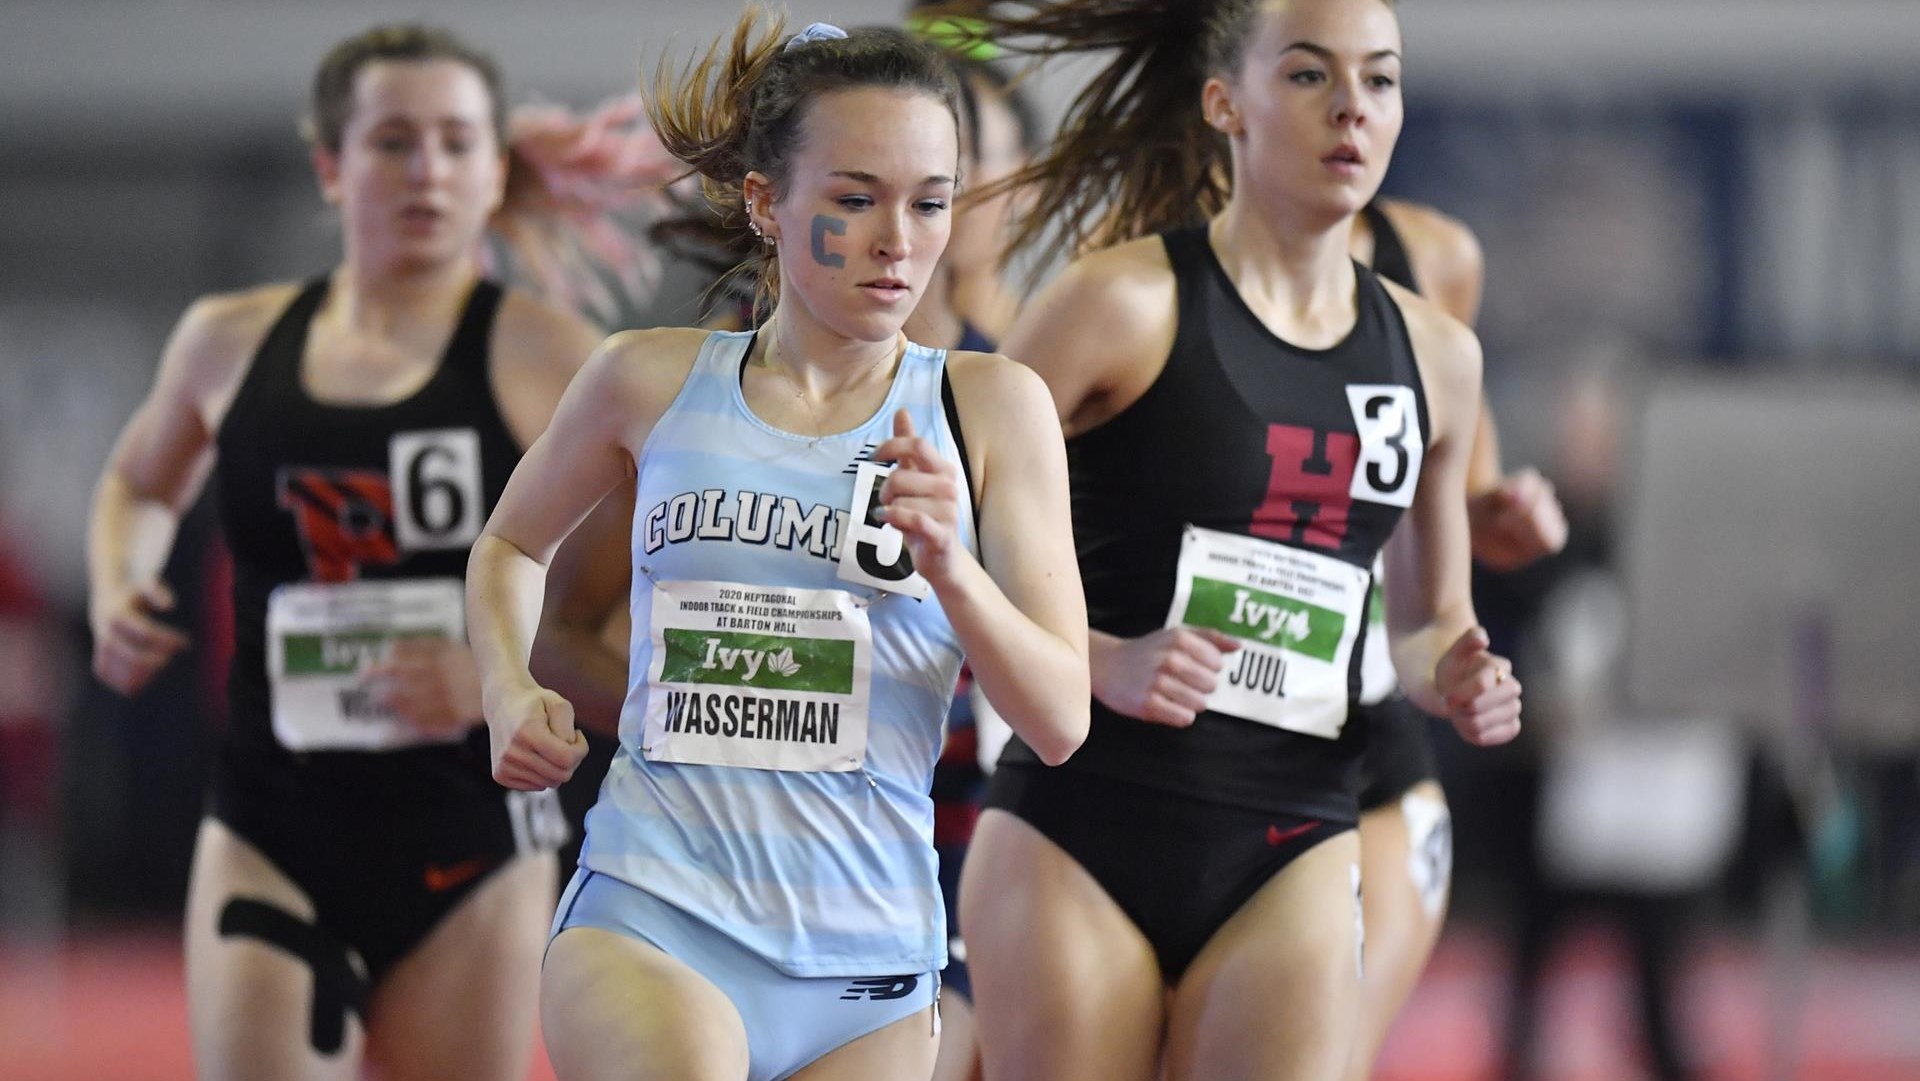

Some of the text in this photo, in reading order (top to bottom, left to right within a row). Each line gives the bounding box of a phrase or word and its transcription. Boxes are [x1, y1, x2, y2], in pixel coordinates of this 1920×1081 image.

[810, 214, 848, 269] C
[1365, 395, 1408, 494] 3
[408, 446, 464, 535] 6
[1249, 423, 1363, 549] H
[856, 474, 915, 581] 5
[680, 601, 843, 621] INDOOR TRACK & FIELD CHAMPIONSHIPS
[719, 589, 796, 606] 2020 HEPTAGONAL
[1229, 589, 1289, 640] Ivy
[717, 617, 796, 634] AT BARTON HALL
[702, 638, 767, 681] Ivy
[1229, 649, 1288, 698] JUUL
[664, 691, 840, 744] WASSERMAN
